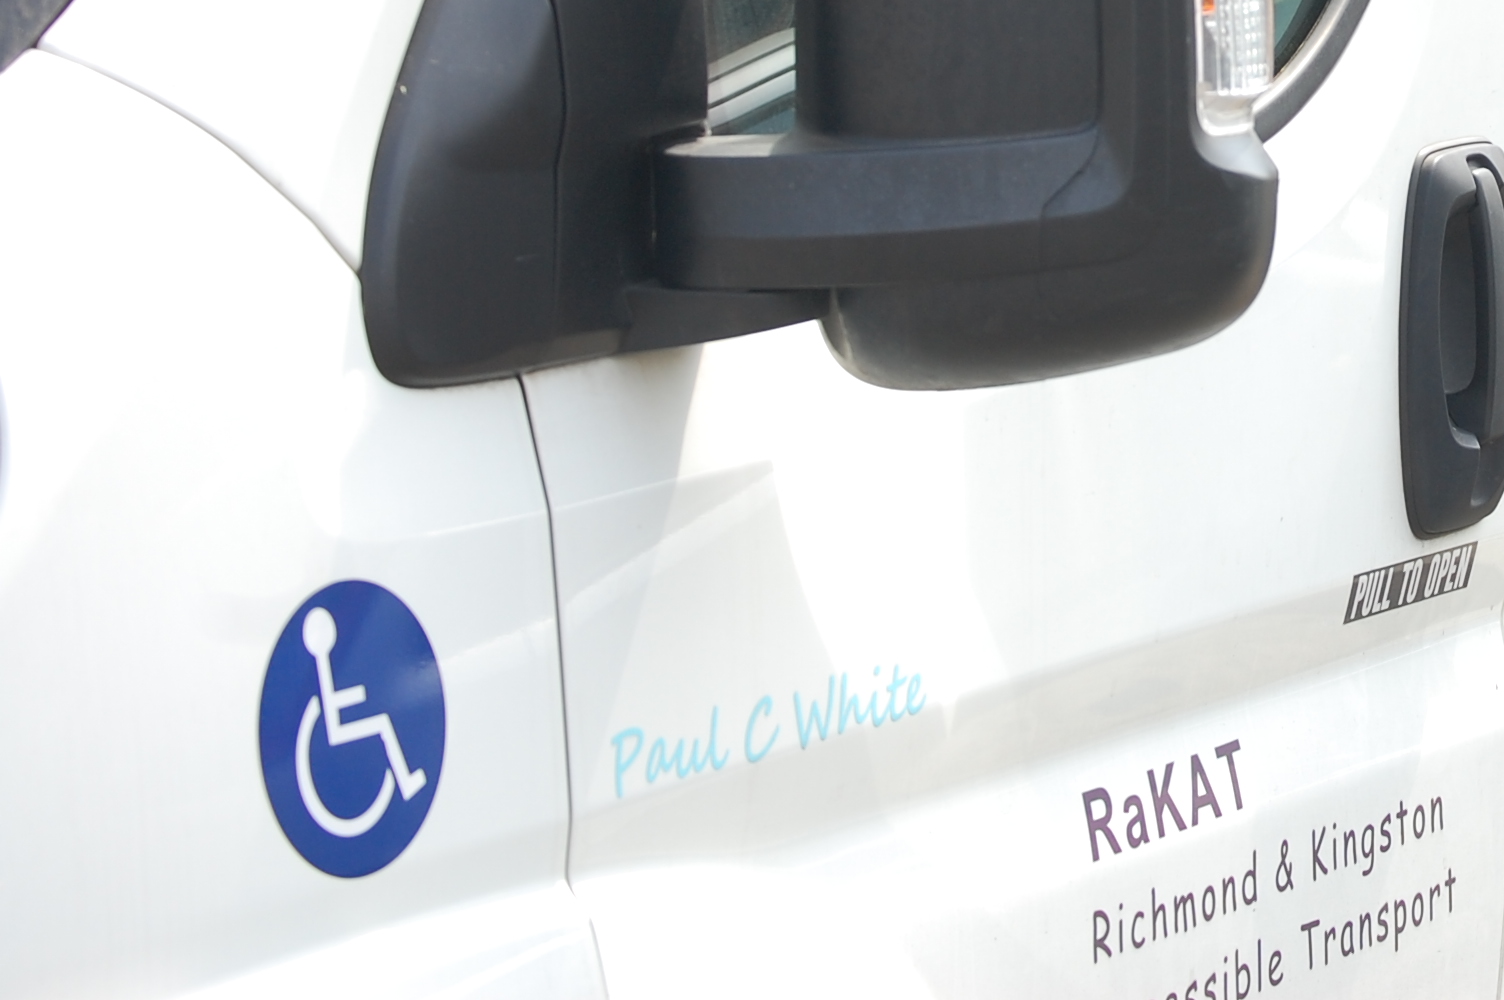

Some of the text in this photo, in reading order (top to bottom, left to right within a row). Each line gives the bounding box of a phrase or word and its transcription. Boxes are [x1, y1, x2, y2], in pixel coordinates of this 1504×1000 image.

[1350, 545, 1473, 620] PULL TO OPEN
[611, 664, 927, 799] Paul C White
[1081, 738, 1244, 863] RaKAT
[1092, 796, 1445, 964] Richmond & Kingston
[1300, 868, 1457, 971] Transport
